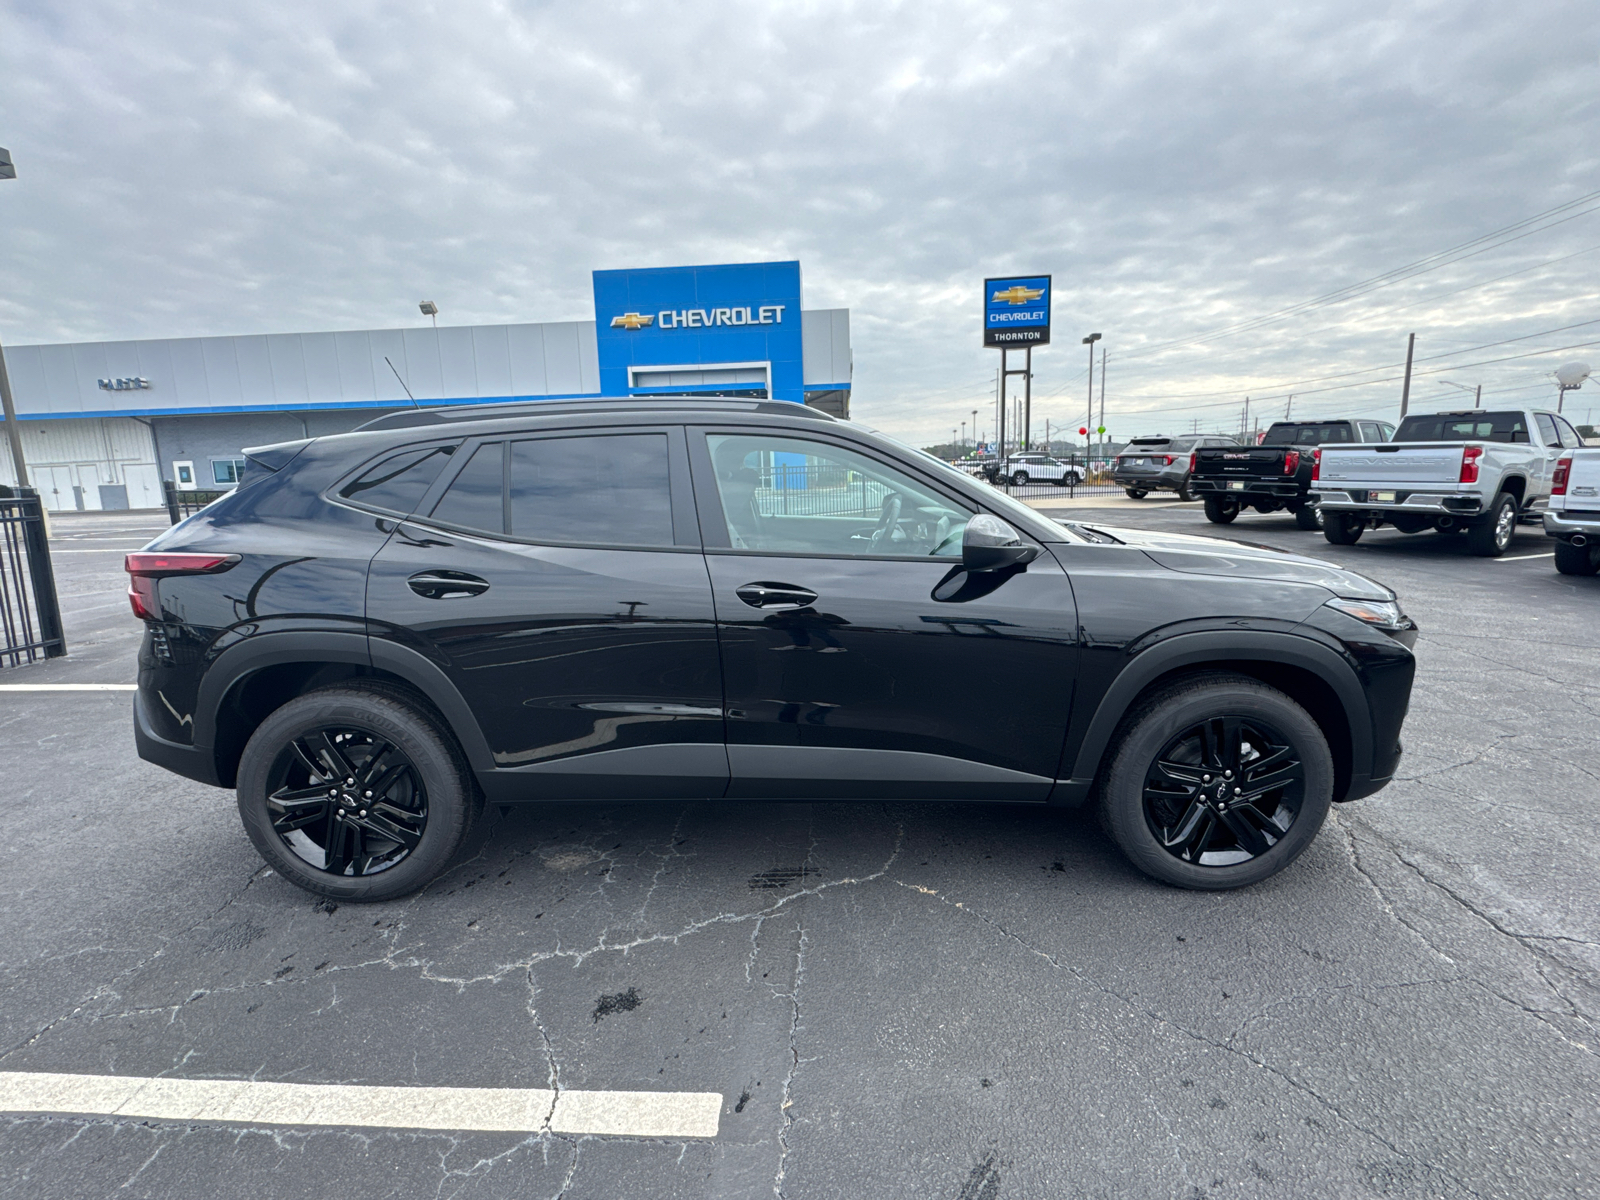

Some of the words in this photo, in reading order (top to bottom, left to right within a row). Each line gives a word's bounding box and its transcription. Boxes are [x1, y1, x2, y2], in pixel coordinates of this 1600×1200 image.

[658, 305, 786, 329] CHEVROLET
[990, 311, 1045, 322] CHEVROLET
[994, 331, 1041, 341] THORNTON
[97, 377, 145, 390] PARTS
[1327, 456, 1452, 466] CHEVROLET
